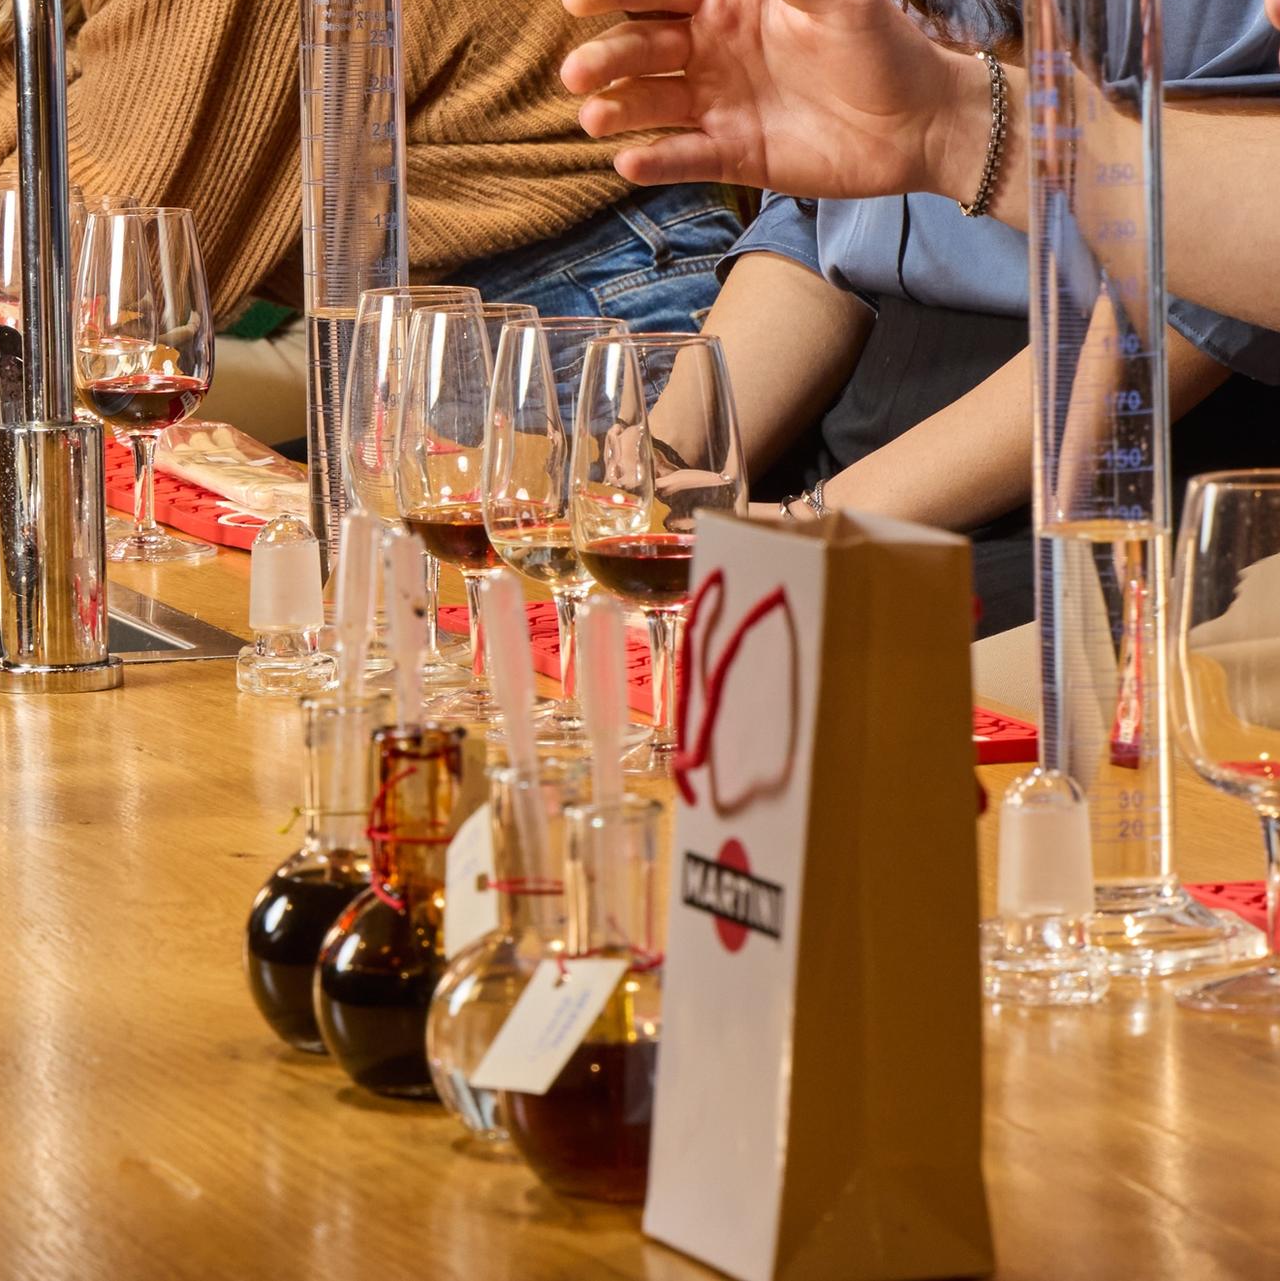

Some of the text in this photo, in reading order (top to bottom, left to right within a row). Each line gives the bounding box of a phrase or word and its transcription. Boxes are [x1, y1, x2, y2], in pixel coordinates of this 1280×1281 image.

[1104, 448, 1141, 468] 150
[1120, 789, 1143, 809] 30
[1119, 819, 1144, 838] 20
[684, 855, 782, 937] MARTINI
